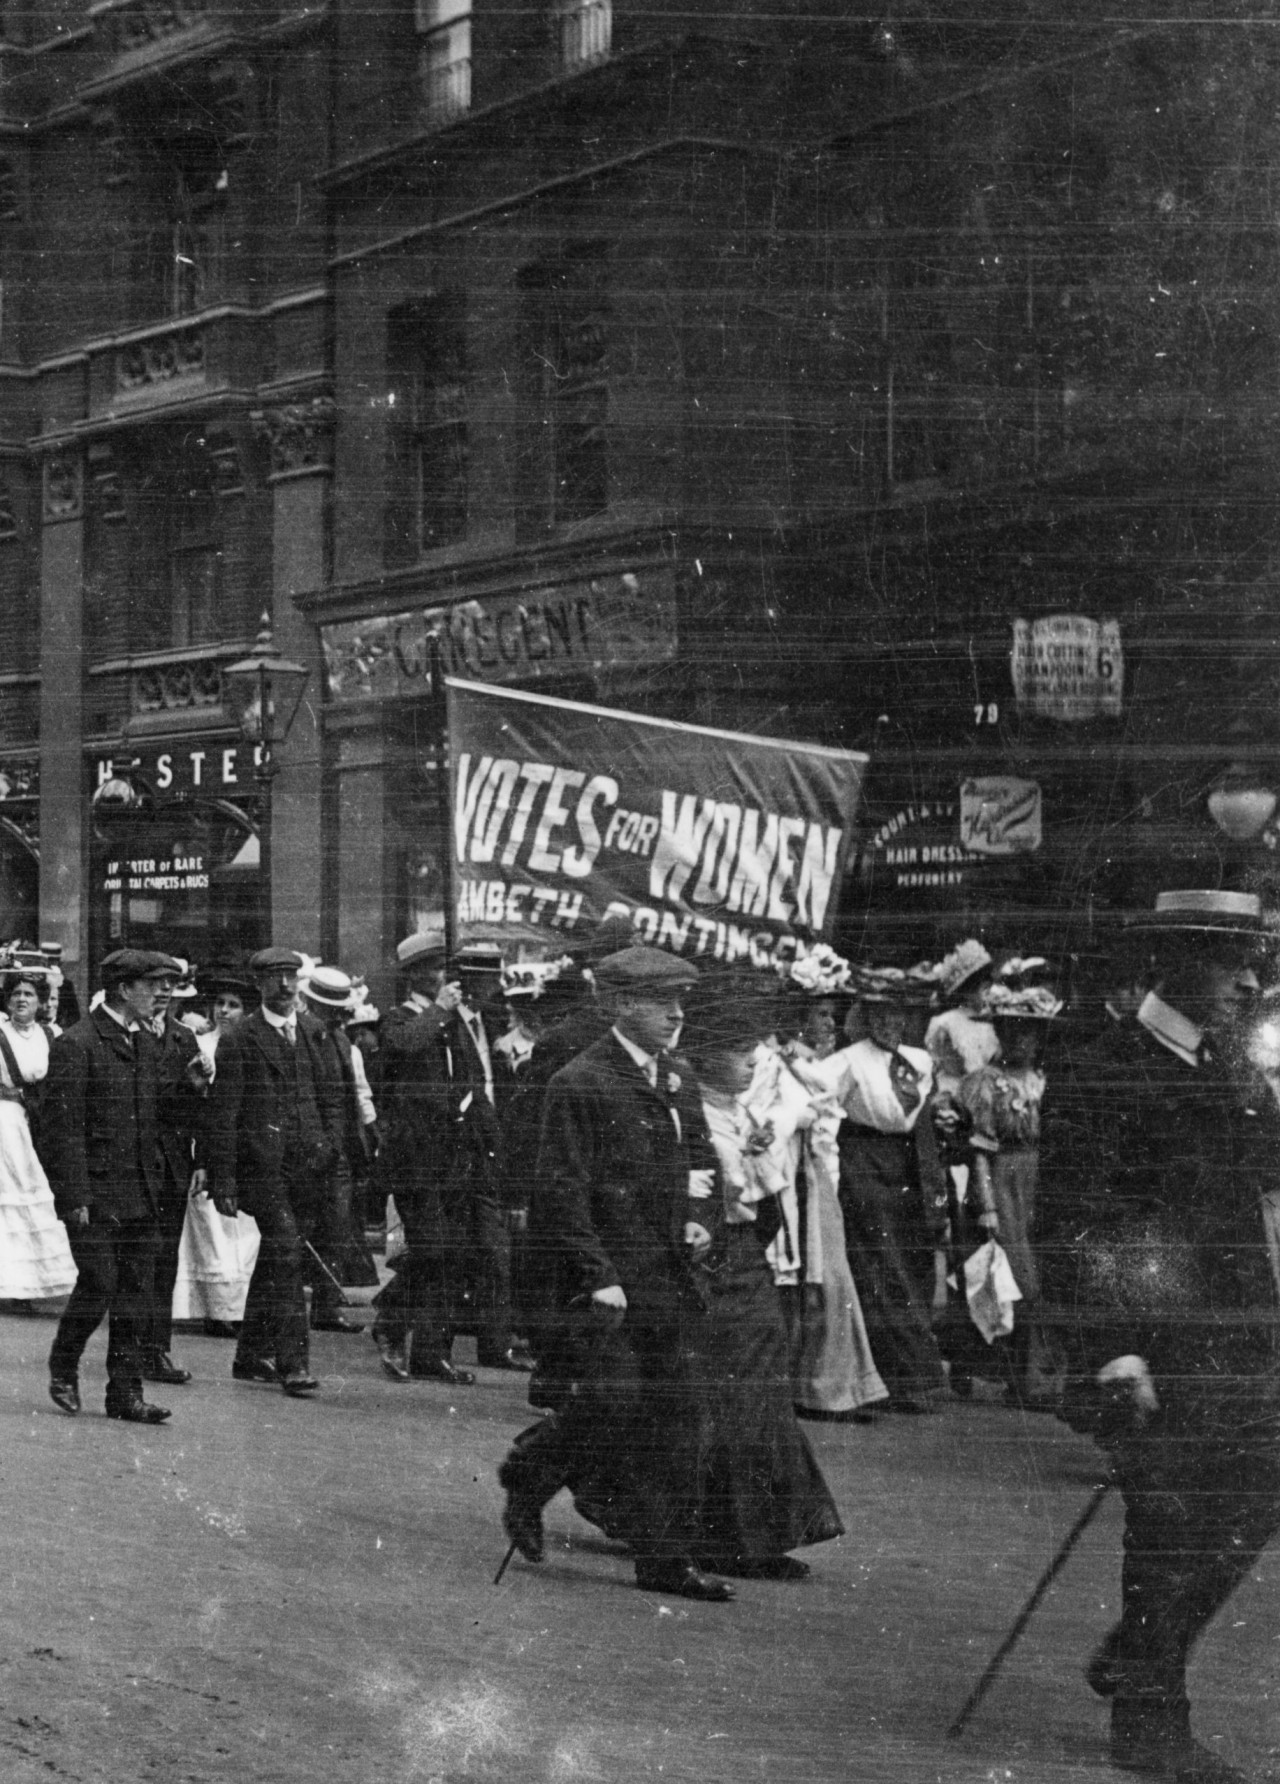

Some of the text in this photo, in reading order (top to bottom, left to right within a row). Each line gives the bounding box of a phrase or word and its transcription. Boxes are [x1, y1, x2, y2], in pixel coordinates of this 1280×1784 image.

[455, 753, 619, 878] VOTES
[604, 808, 659, 856] FOR
[649, 790, 843, 931] WOMEN
[174, 857, 203, 871] RARE
[186, 873, 209, 888] RUGS
